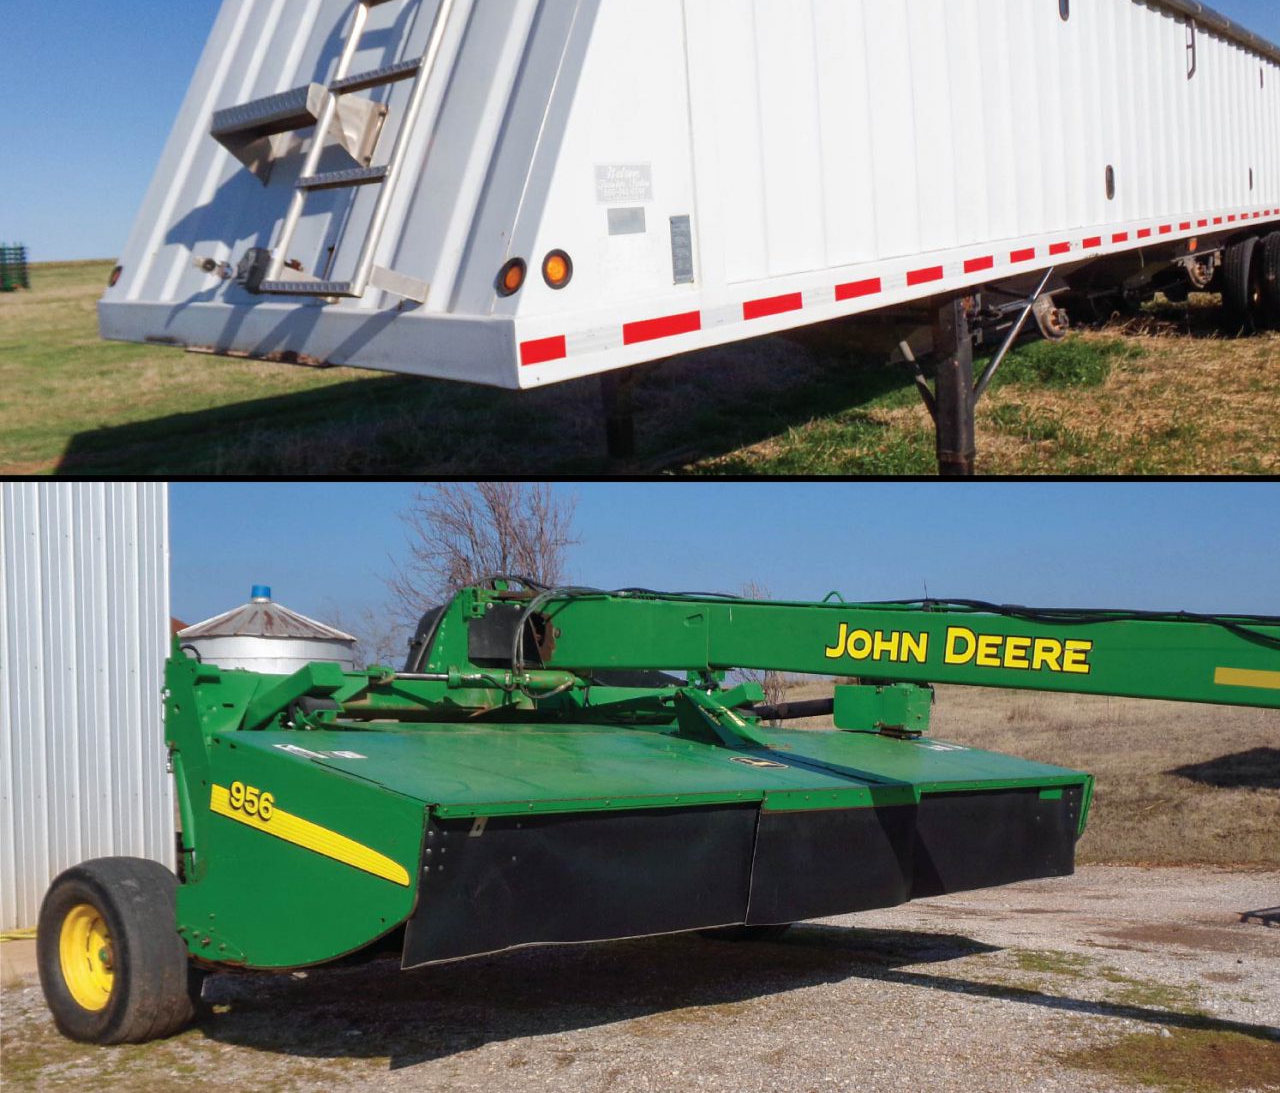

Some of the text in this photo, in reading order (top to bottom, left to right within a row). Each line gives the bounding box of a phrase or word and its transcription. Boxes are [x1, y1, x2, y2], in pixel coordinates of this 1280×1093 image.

[825, 622, 1094, 674] JOHN DEERE
[229, 780, 275, 821] 956
